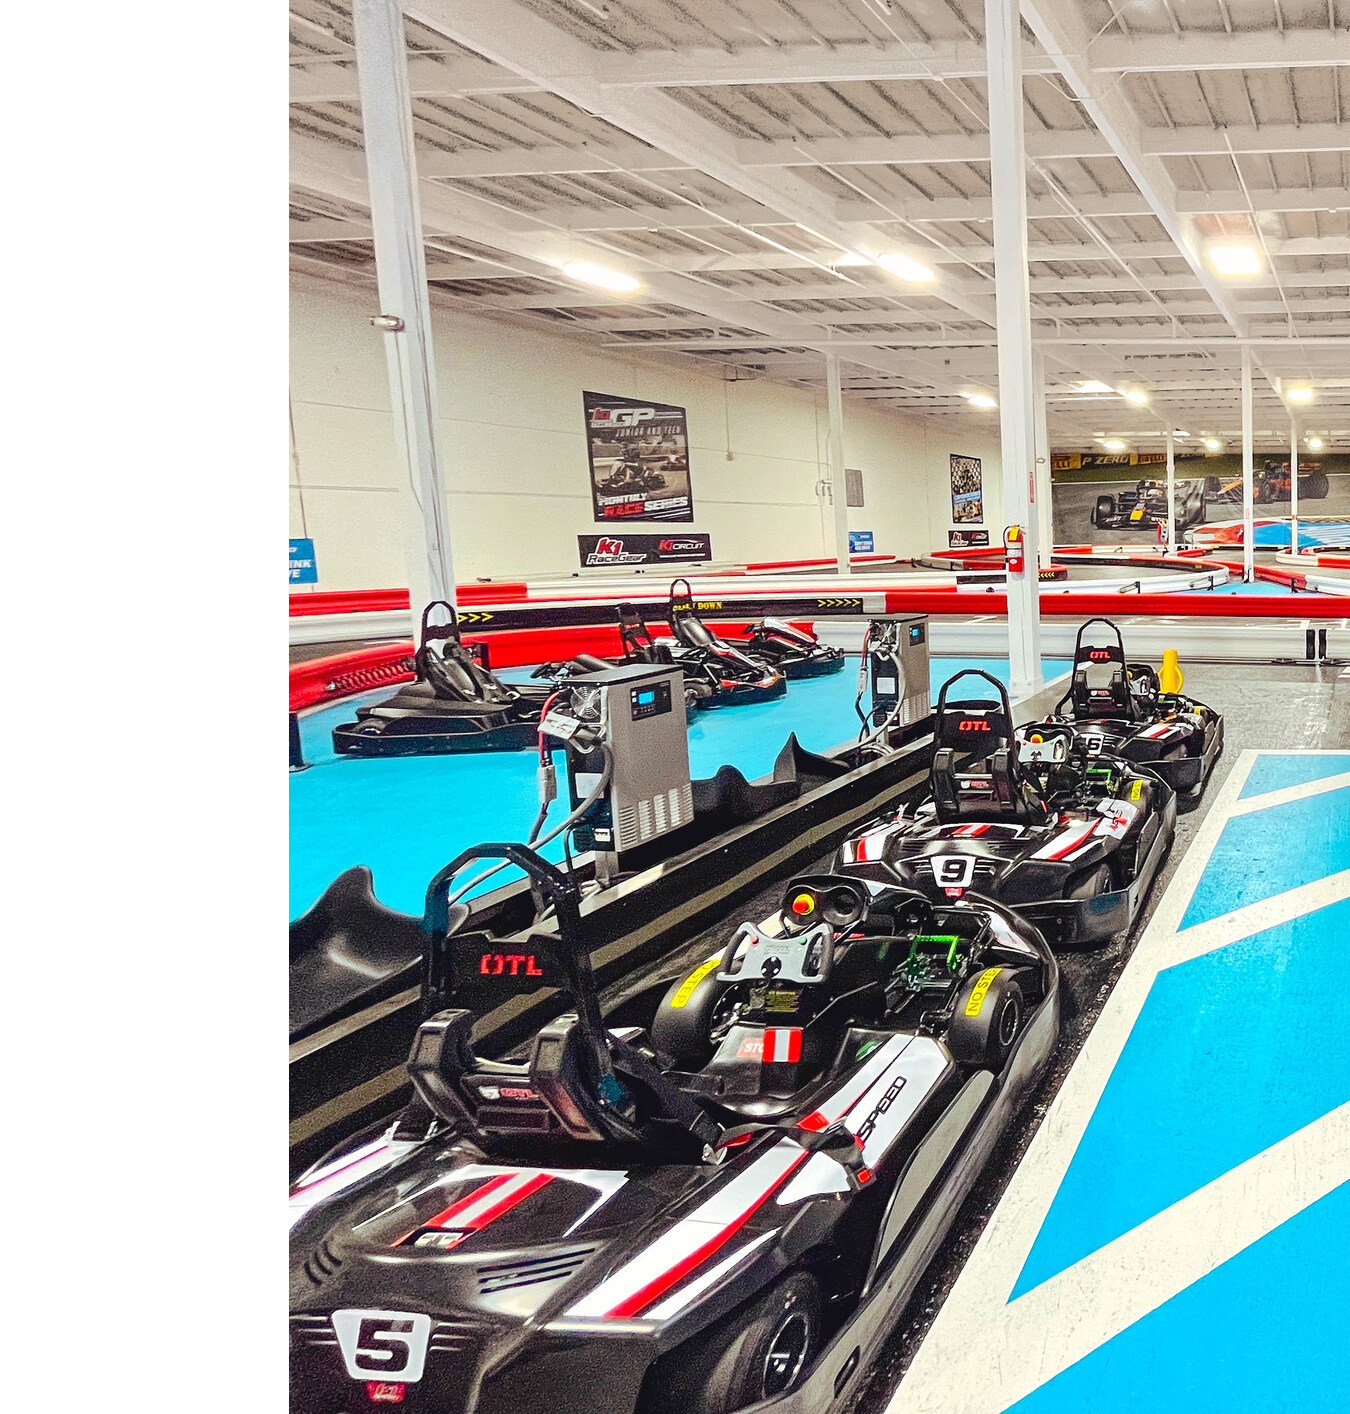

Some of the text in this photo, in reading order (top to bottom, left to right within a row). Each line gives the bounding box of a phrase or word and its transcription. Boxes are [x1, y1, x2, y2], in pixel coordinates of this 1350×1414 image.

[610, 408, 655, 427] GP
[1081, 454, 1129, 466] P ZERO
[603, 496, 688, 517] RACE SERIES
[597, 538, 622, 556] K1
[697, 602, 723, 610] DOWN
[958, 720, 991, 731] OTL
[940, 859, 968, 883] 9
[480, 953, 543, 976] OTL
[677, 971, 705, 1004] STEP
[967, 992, 983, 1012] NO
[355, 1318, 415, 1373] 5
